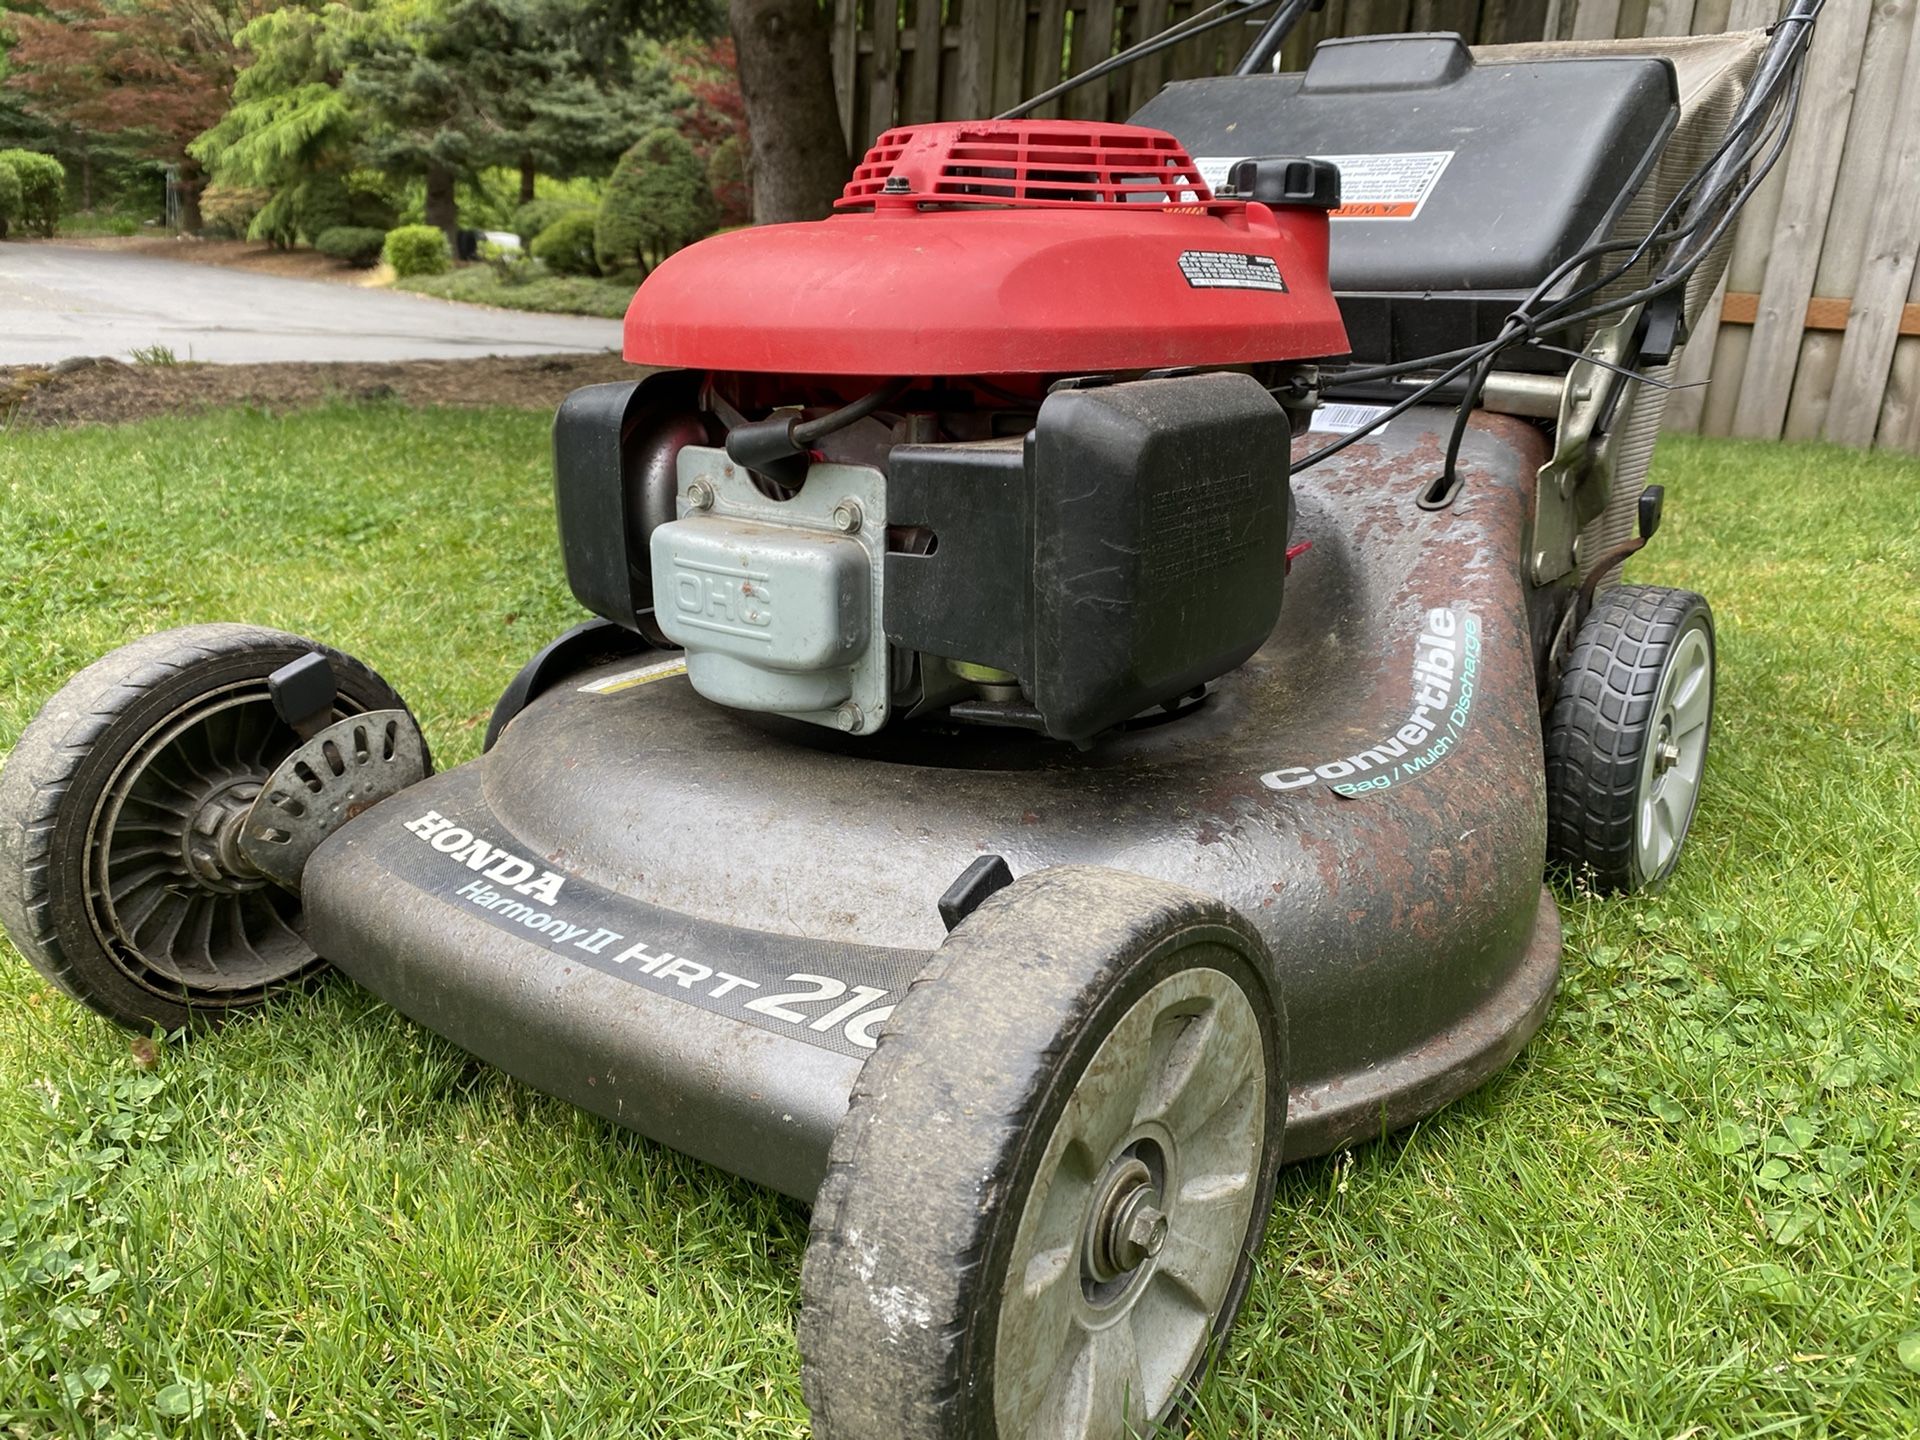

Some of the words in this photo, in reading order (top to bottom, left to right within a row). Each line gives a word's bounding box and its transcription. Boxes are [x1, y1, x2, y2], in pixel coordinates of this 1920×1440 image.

[675, 572, 771, 627] OHC
[1260, 607, 1456, 790] Convertible
[1334, 774, 1391, 796] Bag
[1403, 735, 1453, 774] Mulch
[1451, 618, 1480, 728] Discharge
[403, 810, 566, 907] HONDA
[456, 879, 588, 943] Harmony
[612, 942, 760, 999] HRT
